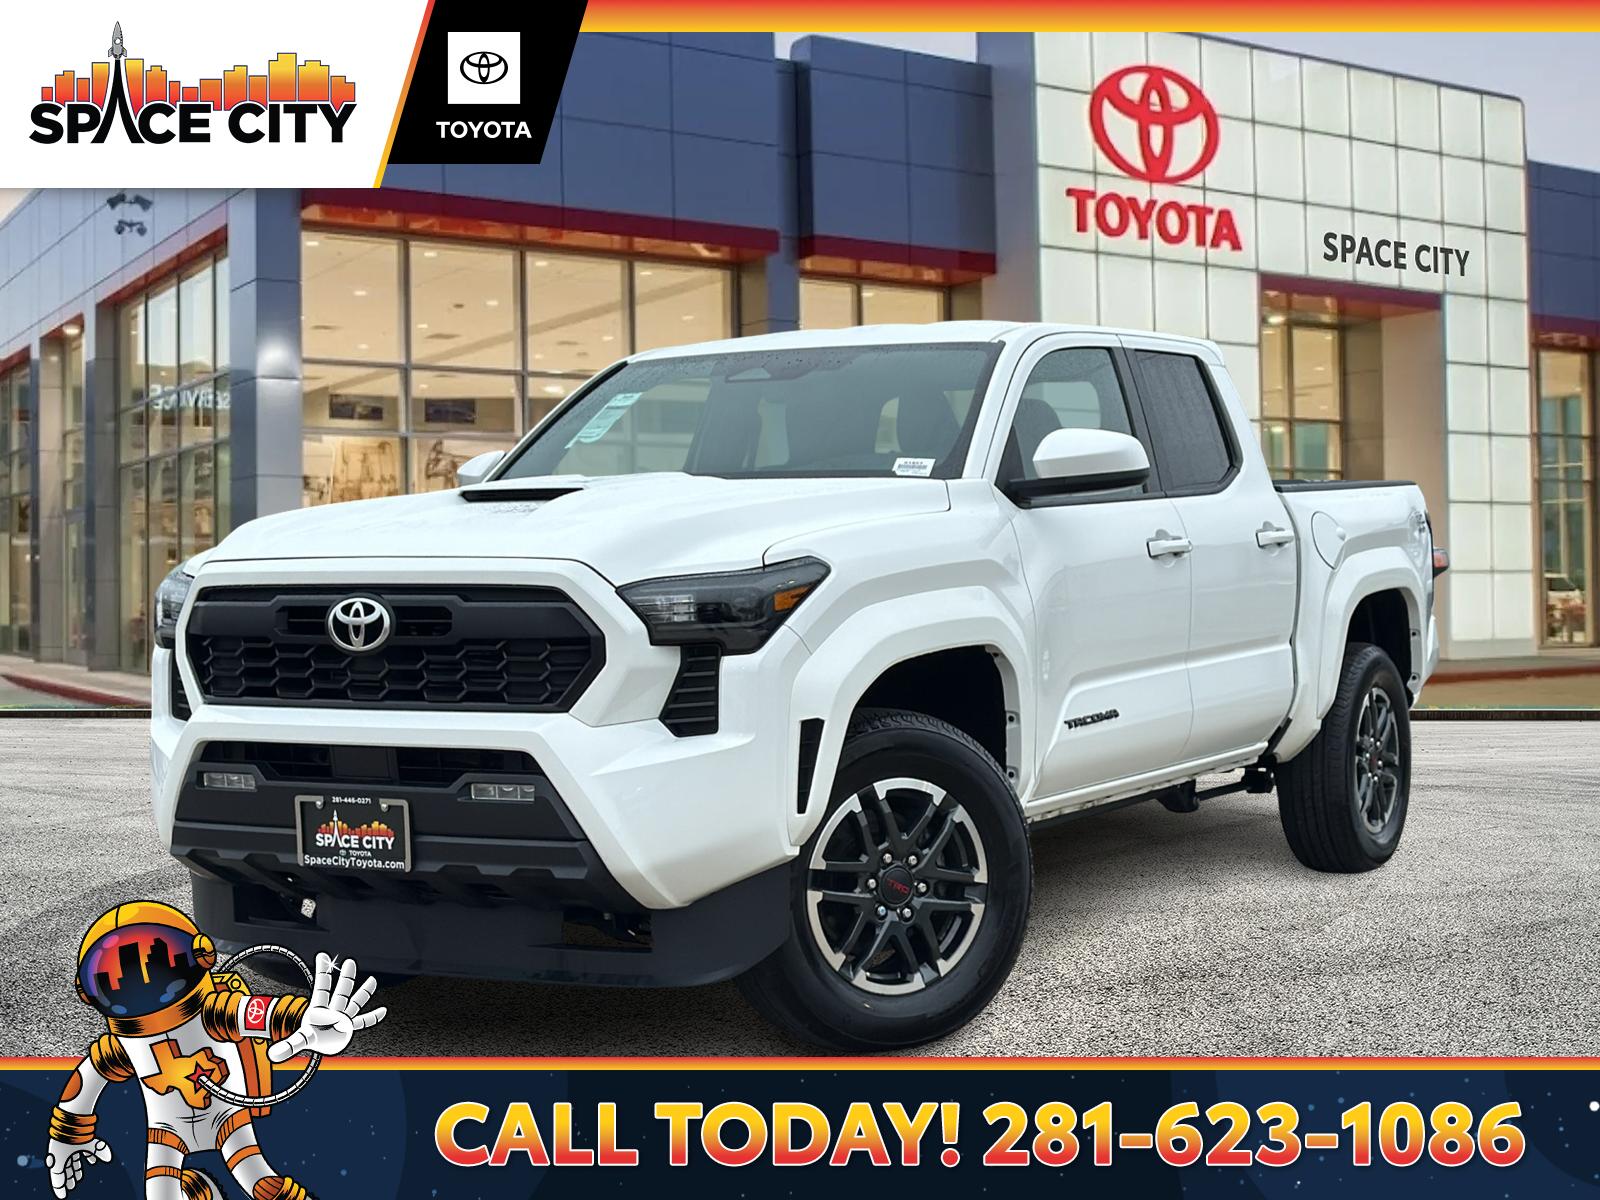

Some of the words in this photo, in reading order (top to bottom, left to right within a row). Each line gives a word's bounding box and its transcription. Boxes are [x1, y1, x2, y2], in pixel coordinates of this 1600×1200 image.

[1066, 187, 1243, 251] TOYOTA
[1322, 231, 1407, 270] SPACE
[1414, 243, 1471, 277] CITY
[315, 833, 359, 848] SPACE
[362, 835, 395, 850] CITY
[304, 854, 405, 869] SpaceCityToyota.com
[348, 849, 372, 857] TOYOTA
